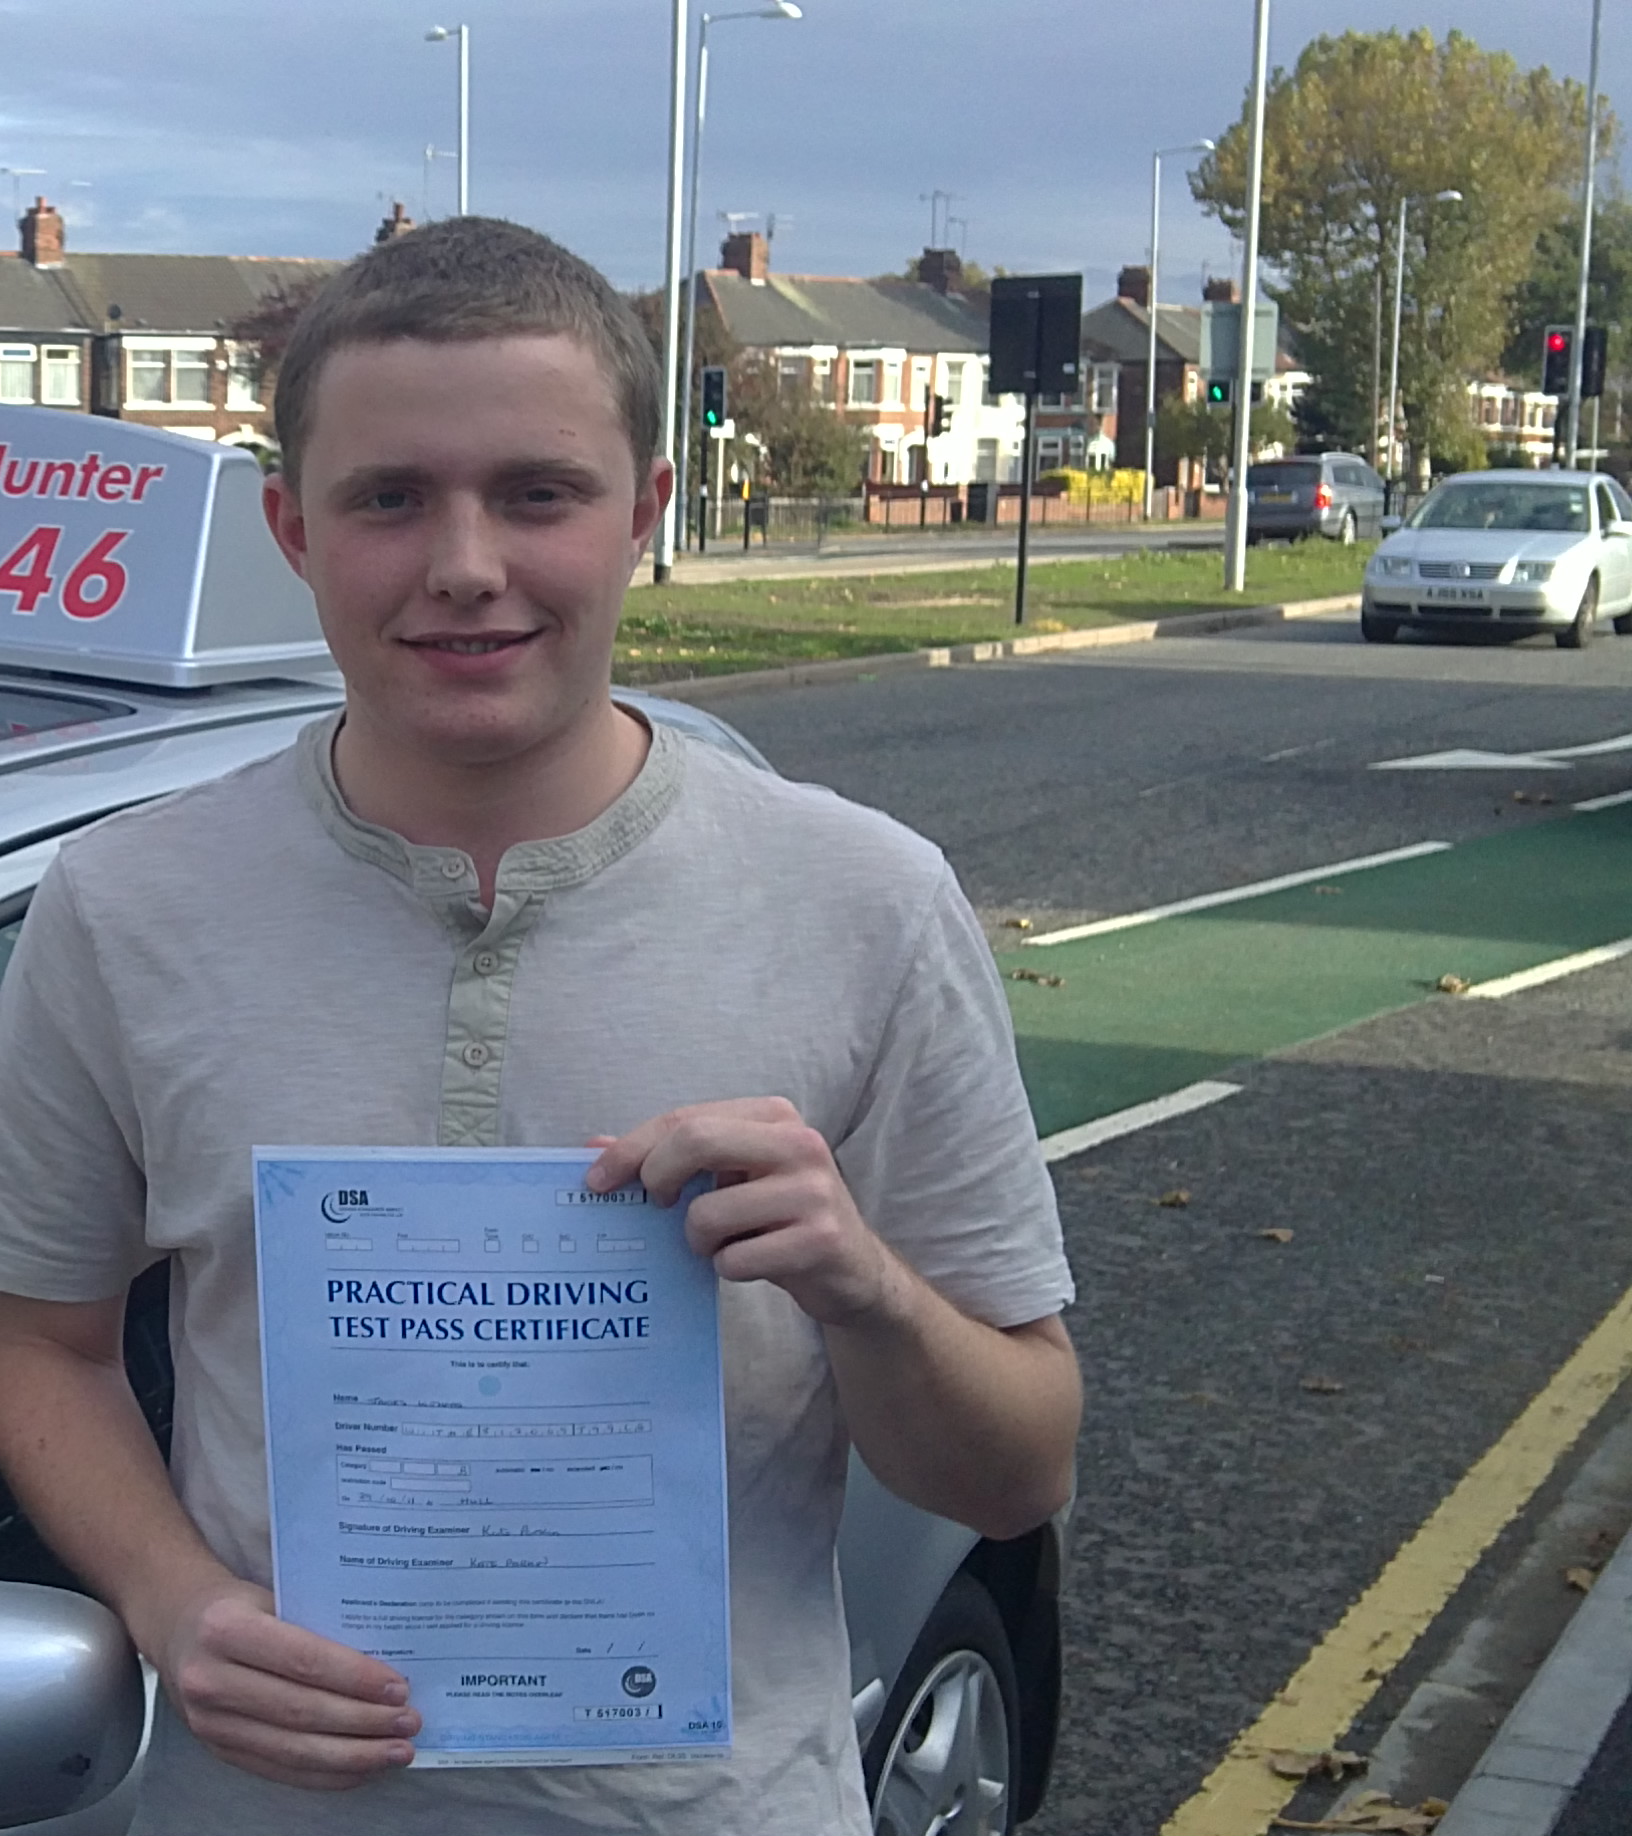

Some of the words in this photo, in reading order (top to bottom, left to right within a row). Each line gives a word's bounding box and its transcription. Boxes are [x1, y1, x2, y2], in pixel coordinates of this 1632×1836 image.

[338, 1190, 369, 1206] DSA
[327, 1280, 495, 1305] PRACTICAL
[508, 1280, 649, 1306] DRIVING
[330, 1316, 389, 1339] TEST
[401, 1317, 464, 1340] PASS
[474, 1316, 650, 1341] CERTIFICATE
[333, 1393, 358, 1402] Name
[335, 1421, 361, 1430] Driver
[363, 1423, 398, 1432] Number
[355, 1445, 387, 1454] Passed
[338, 1521, 380, 1532] Signature
[382, 1524, 391, 1532] of
[394, 1525, 425, 1535] Driving
[427, 1526, 470, 1534] Examiner
[339, 1555, 364, 1564] Name
[366, 1557, 375, 1565] of
[377, 1558, 409, 1568] Driving
[412, 1558, 453, 1567] Examiner
[461, 1674, 547, 1686] IMPORTANT
[688, 1721, 710, 1730] DSA
